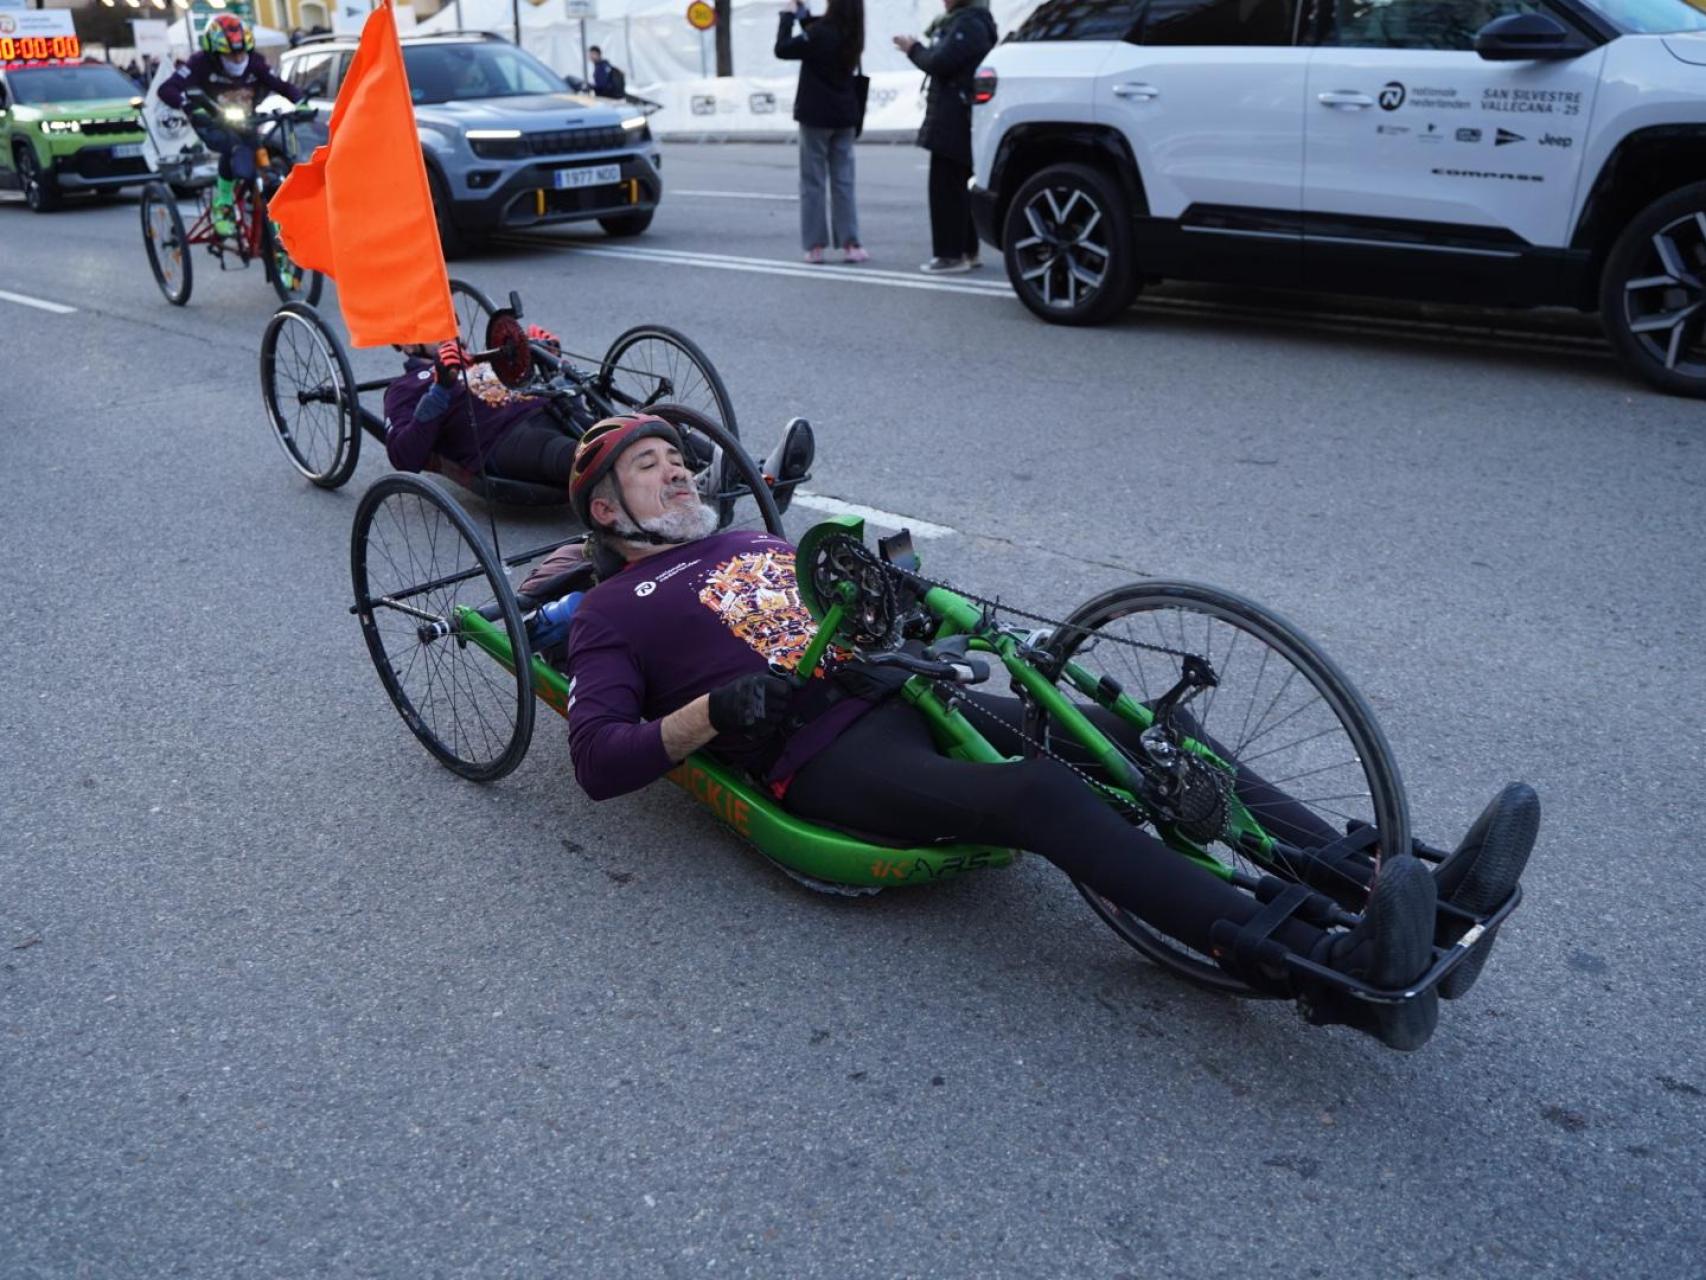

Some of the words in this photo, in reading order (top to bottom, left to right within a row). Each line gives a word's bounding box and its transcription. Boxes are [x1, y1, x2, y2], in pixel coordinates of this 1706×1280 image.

[0, 37, 79, 60] 0:00:00
[1482, 88, 1509, 100] SAN
[1512, 88, 1582, 103] SILVESTRE
[1481, 101, 1553, 114] VALLECANA
[1563, 104, 1580, 116] 25
[1538, 132, 1573, 149] Jeep
